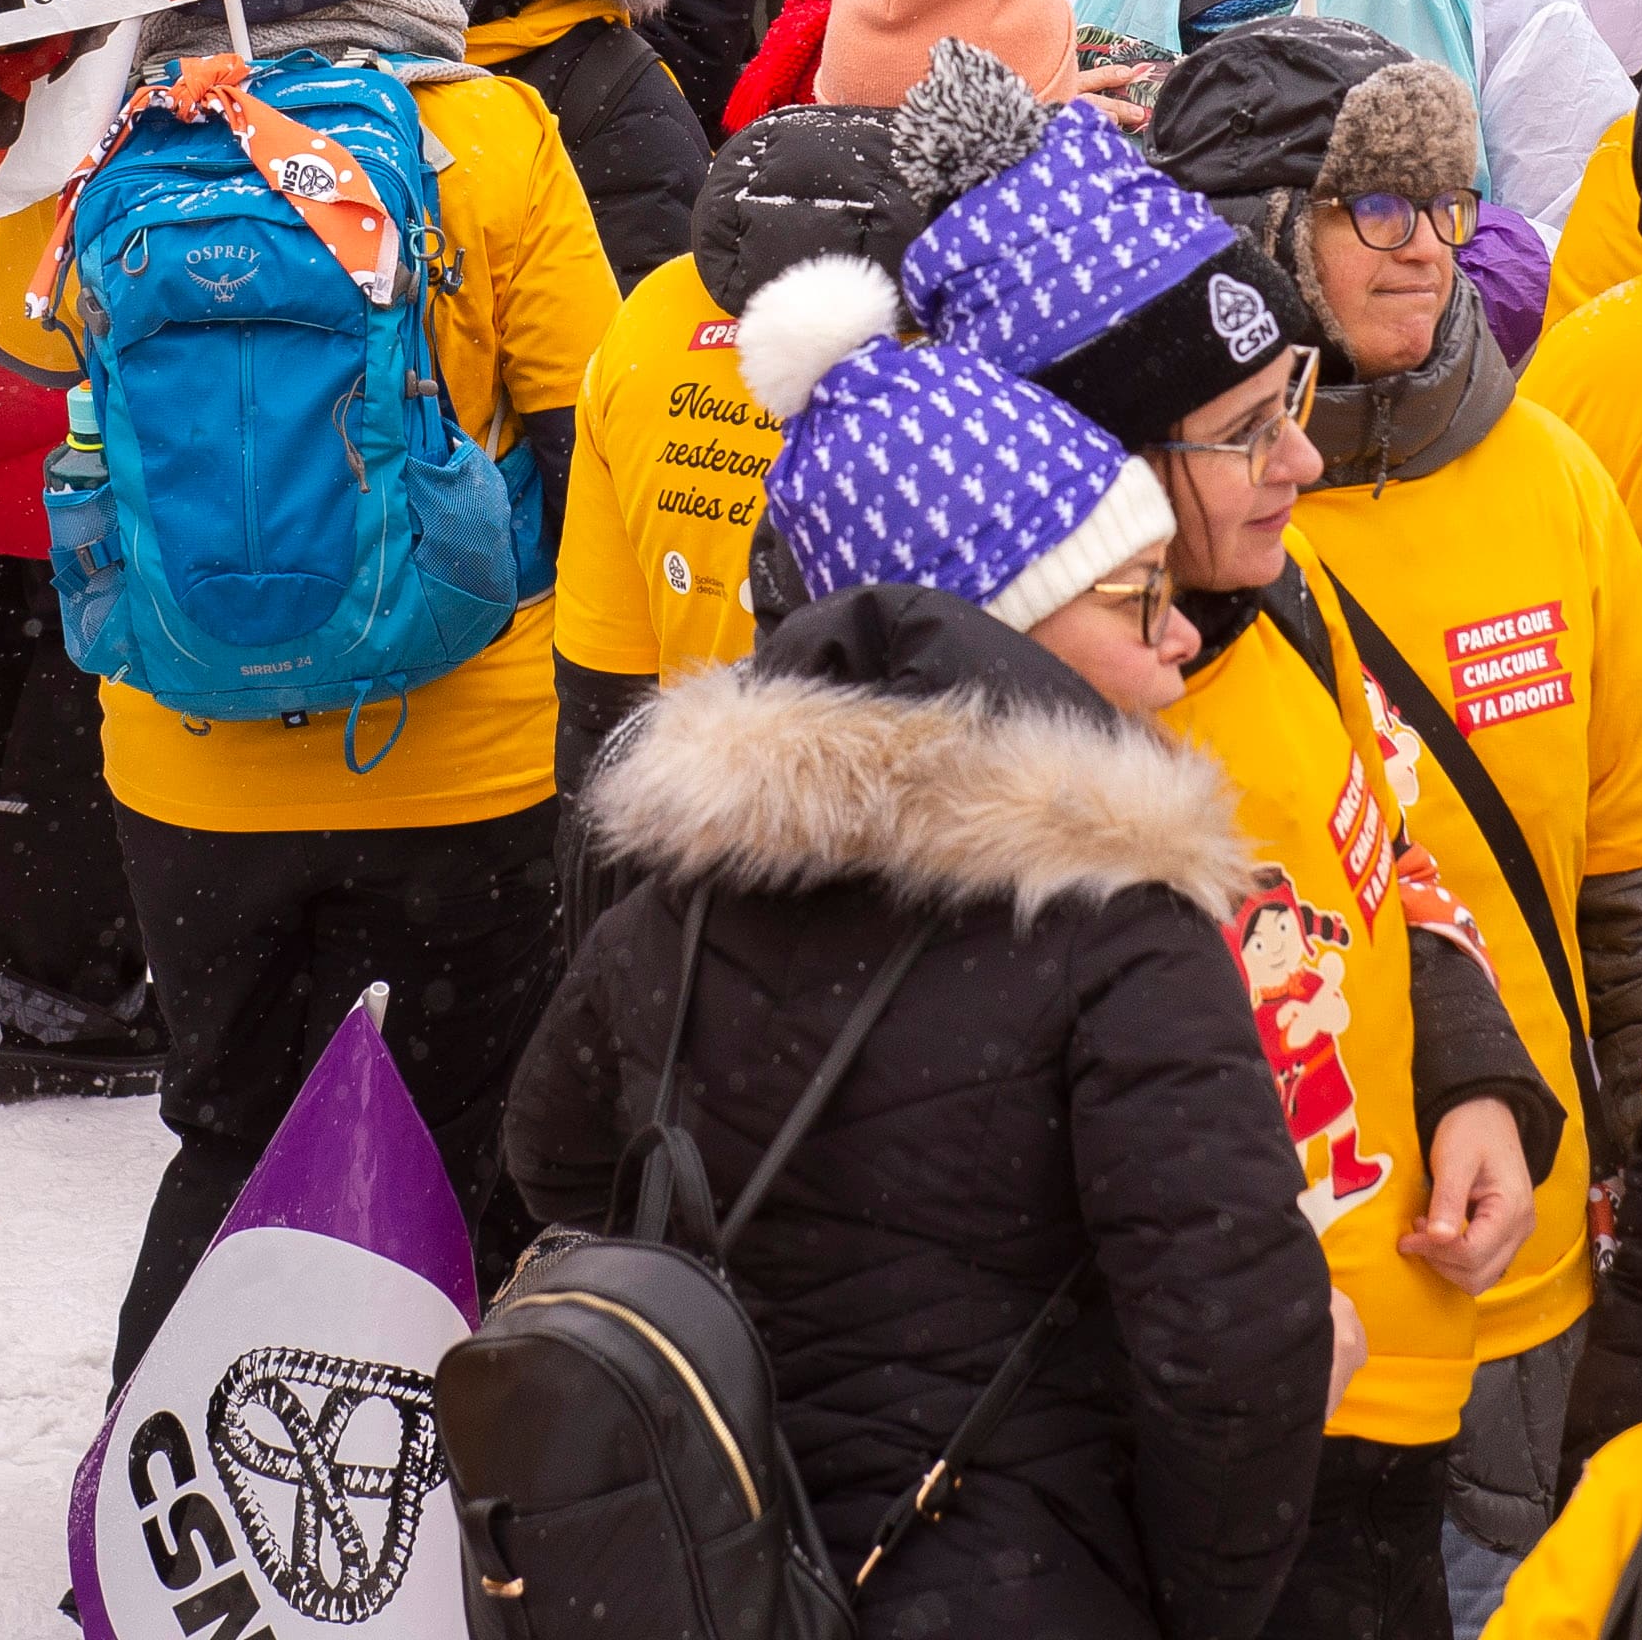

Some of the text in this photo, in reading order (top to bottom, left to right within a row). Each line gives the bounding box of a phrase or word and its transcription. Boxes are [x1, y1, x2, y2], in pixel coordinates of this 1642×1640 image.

[281, 160, 299, 192] CSN
[186, 245, 261, 264] OSPREY
[1236, 321, 1274, 357] CSN
[669, 383, 751, 427] Nous
[656, 439, 772, 481] resteron
[658, 486, 757, 527] unies et
[670, 578, 687, 591] CSN
[1457, 609, 1554, 654] PARCE QUE
[240, 656, 312, 676] SIRRUS 24
[1462, 647, 1549, 689] CHACUNE
[1467, 680, 1564, 725] Y A DROIT!
